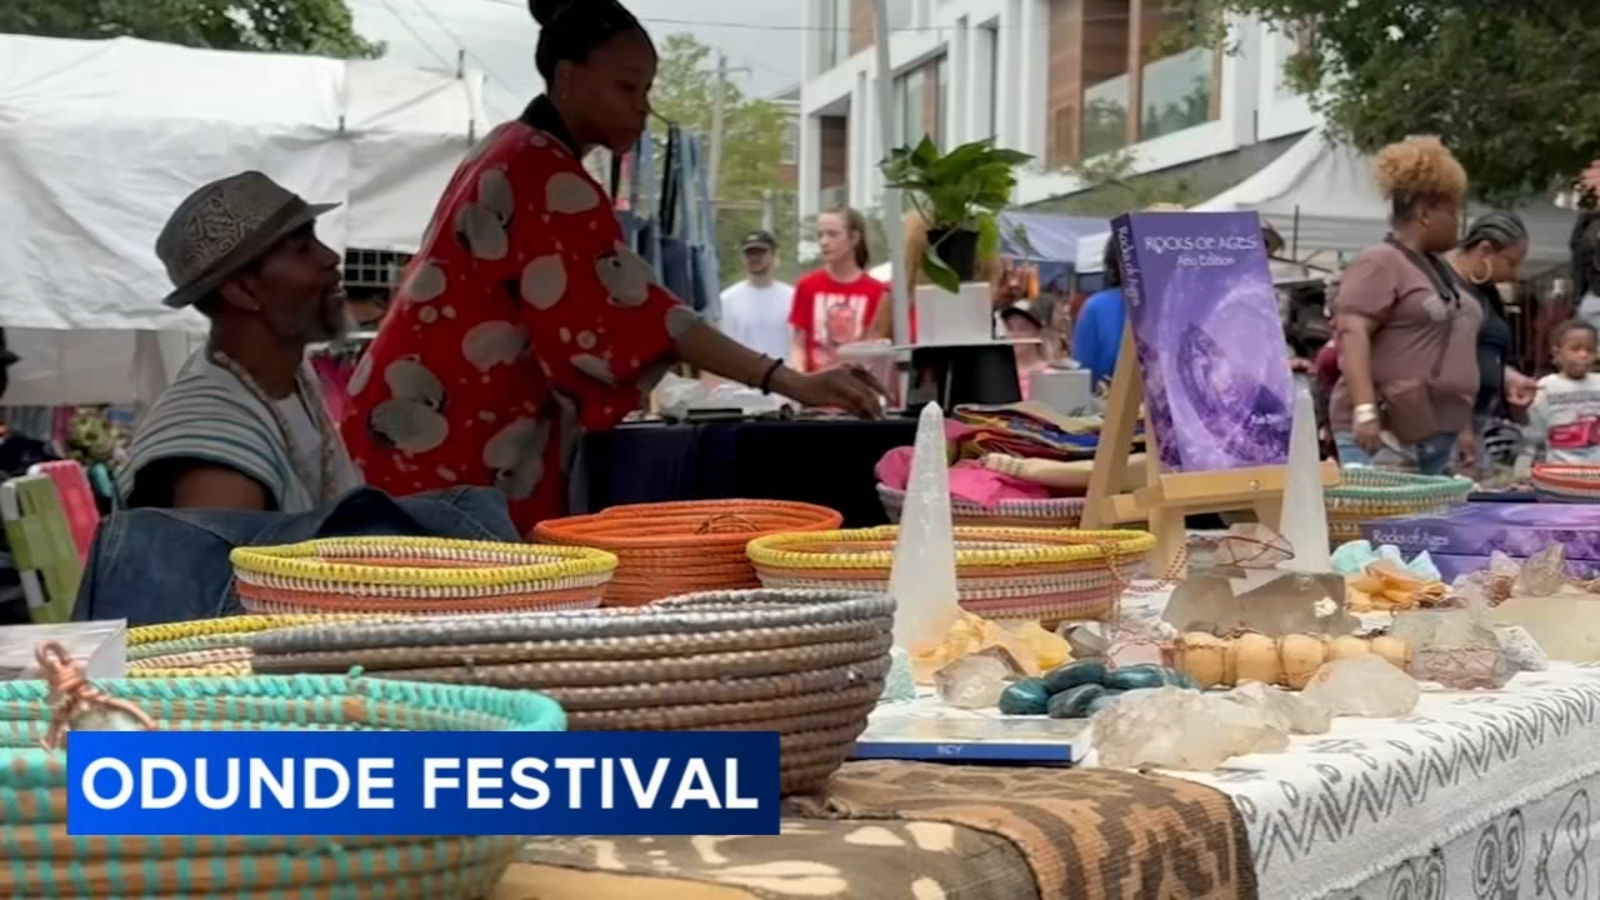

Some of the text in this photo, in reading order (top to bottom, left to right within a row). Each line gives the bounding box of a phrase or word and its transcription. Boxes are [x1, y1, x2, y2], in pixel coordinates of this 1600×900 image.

[1144, 235, 1257, 254] ROCKS OF AGES
[1372, 527, 1406, 544] Rocks
[1420, 532, 1449, 552] Ages
